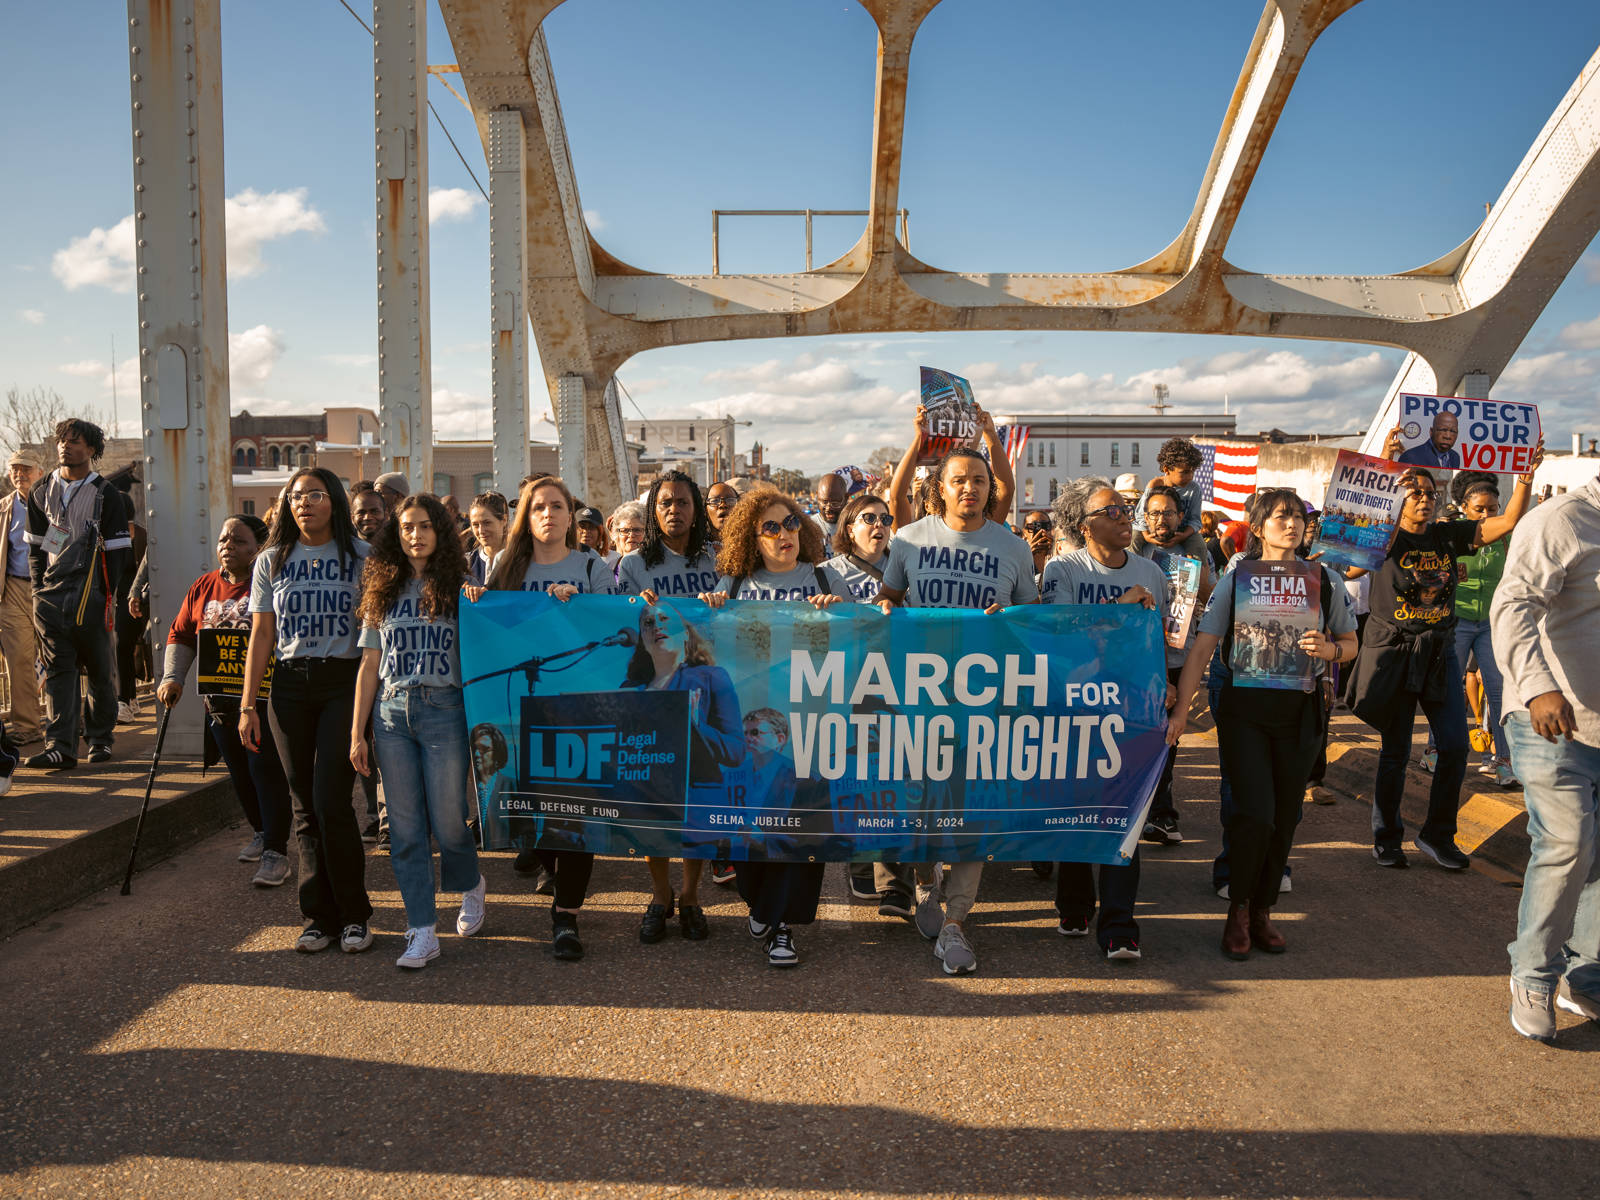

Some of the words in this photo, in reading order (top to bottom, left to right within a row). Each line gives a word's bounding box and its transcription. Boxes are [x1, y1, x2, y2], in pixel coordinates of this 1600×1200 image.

[1405, 396, 1533, 424] PROTECT
[928, 418, 955, 437] LET
[958, 421, 977, 438] US
[1469, 422, 1529, 445] OUR
[1461, 443, 1534, 472] VOTE!
[1339, 465, 1399, 494] MARCH
[1335, 487, 1364, 505] VOTING
[1364, 494, 1394, 511] RIGHTS
[281, 558, 355, 582] MARCH
[918, 546, 999, 578] MARCH
[917, 579, 998, 609] VOTING
[1250, 577, 1307, 595] SELMA
[278, 589, 352, 614] VOTING
[1170, 602, 1185, 618] US
[1249, 595, 1285, 605] JUBILEE
[1287, 596, 1307, 607] 2024
[281, 614, 350, 639] RIGHTS
[384, 625, 454, 652] VOTING
[216, 635, 239, 647] WE
[220, 649, 237, 660] BE
[387, 651, 450, 677] RIGHTS
[789, 649, 1048, 707] MARCH
[1066, 682, 1121, 707] FOR
[529, 732, 616, 780] LDF
[618, 730, 656, 748] Legal
[618, 750, 675, 765] Defense
[789, 712, 955, 782] VOTING
[965, 713, 1125, 782] RIGHTS
[617, 766, 650, 781] Fund
[728, 785, 746, 808] IR
[837, 789, 897, 823] FAIR
[500, 800, 534, 810] LEGAL
[540, 801, 586, 815] DEFENSE
[593, 807, 619, 818] FUND
[709, 814, 745, 825] SELMA
[751, 816, 801, 827] JUBILEE
[1044, 814, 1128, 828] naacpldf.org
[858, 818, 894, 828] MARCH
[901, 818, 928, 830] 1-3,
[936, 817, 964, 828] 2024
